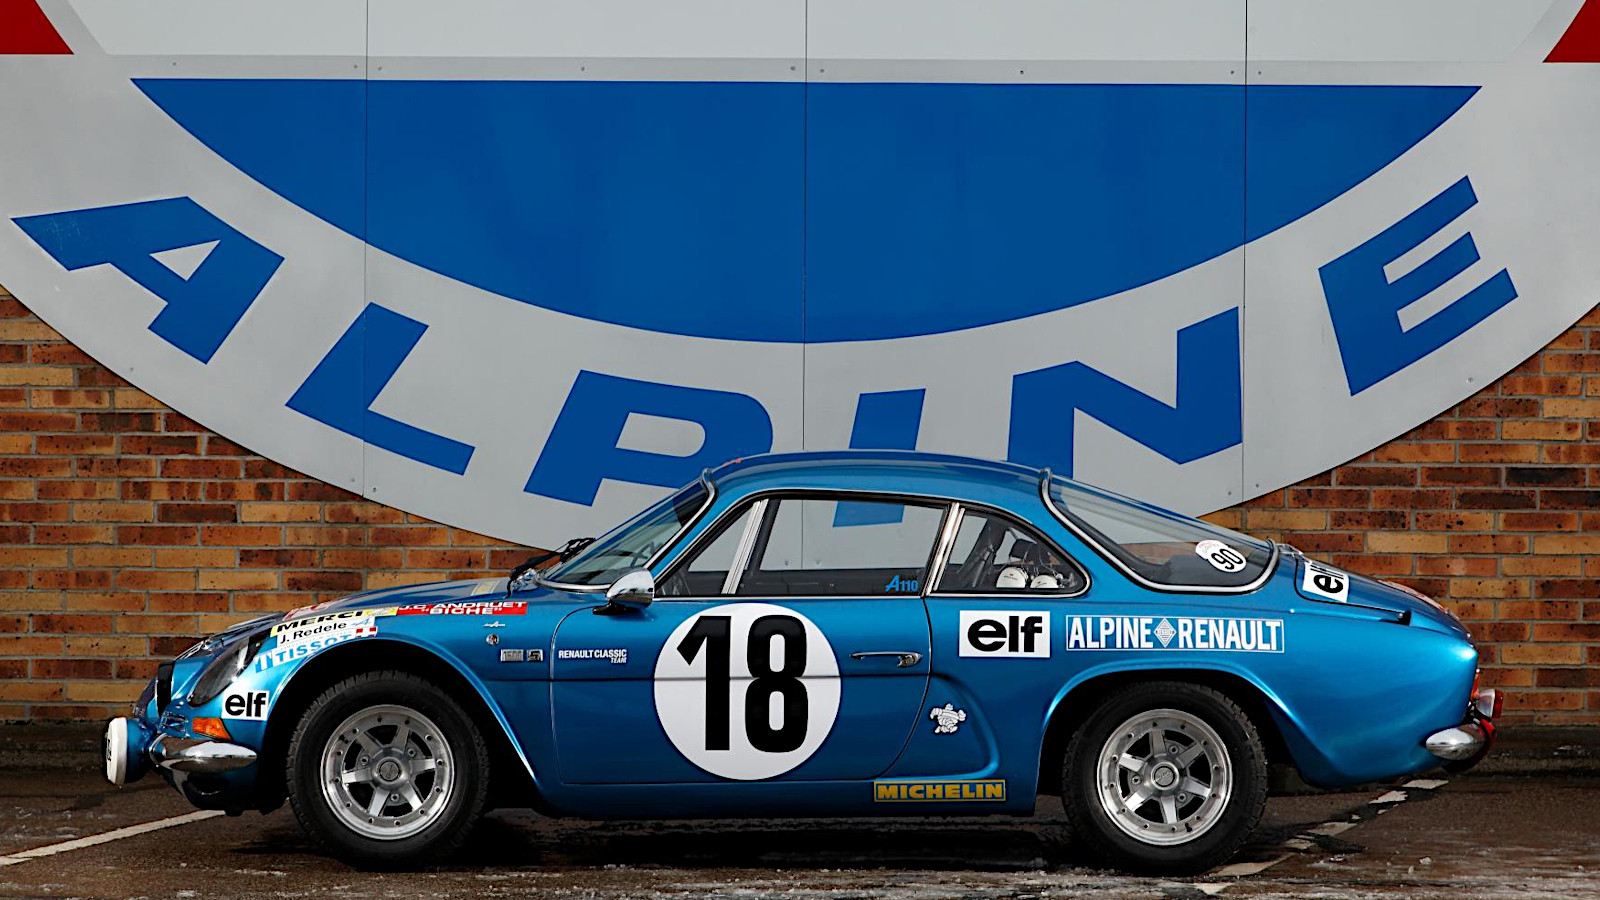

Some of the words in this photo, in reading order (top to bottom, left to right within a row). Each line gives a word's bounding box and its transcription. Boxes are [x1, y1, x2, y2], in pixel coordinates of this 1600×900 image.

[11, 175, 1518, 527] ALPINE
[1211, 548, 1244, 570] 90
[884, 575, 919, 593] A110
[277, 611, 363, 632] MERCI
[293, 622, 347, 639] Redele
[967, 615, 1043, 652] elf
[1068, 617, 1154, 649] ALPINE
[1178, 619, 1281, 651] RENAULT
[275, 634, 351, 662] TISSOT
[558, 650, 594, 659] RENAULT
[594, 649, 627, 658] CLASSIC
[676, 614, 809, 753] 18
[225, 692, 267, 717] elf
[877, 784, 1002, 799] MICHELIN
